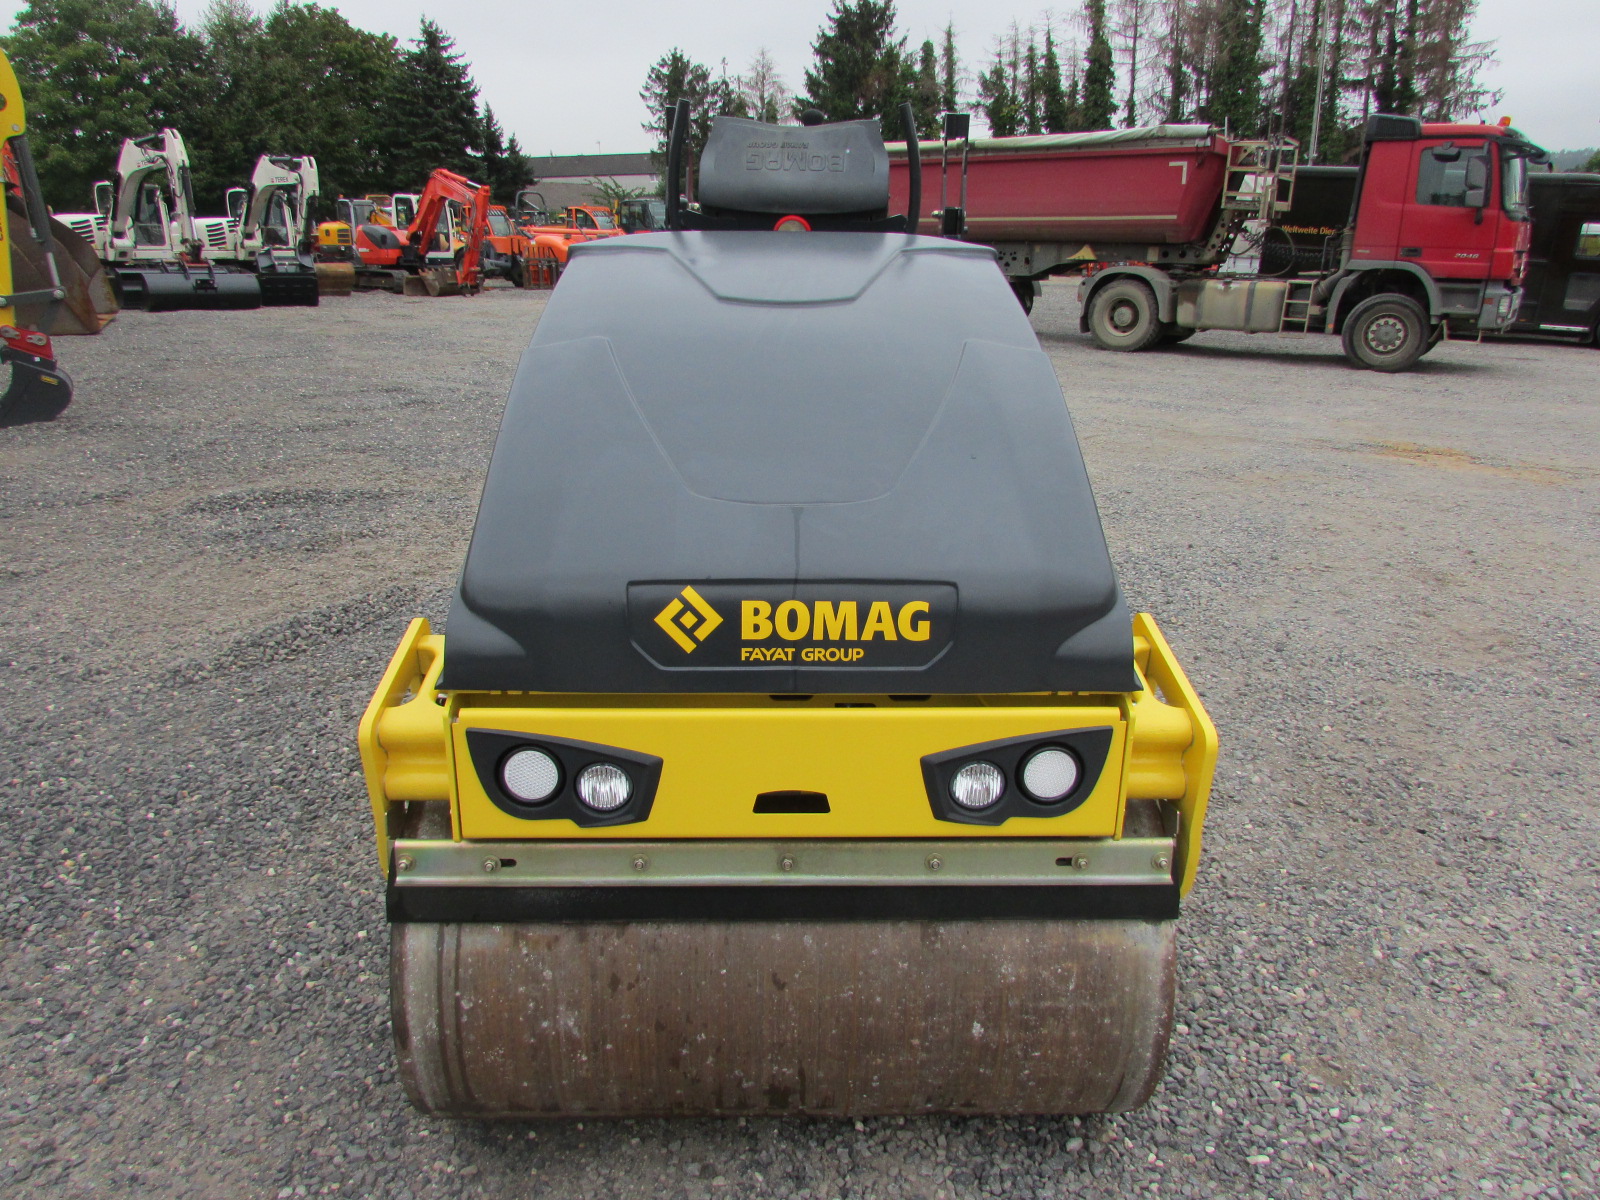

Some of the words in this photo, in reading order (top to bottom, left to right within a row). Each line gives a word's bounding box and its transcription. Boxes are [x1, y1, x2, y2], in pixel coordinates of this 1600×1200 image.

[745, 151, 845, 173] BOMAG
[1281, 225, 1319, 235] Weltweite
[741, 600, 931, 641] BOMAG
[741, 647, 796, 662] FAYAT
[801, 647, 864, 662] GROUP
